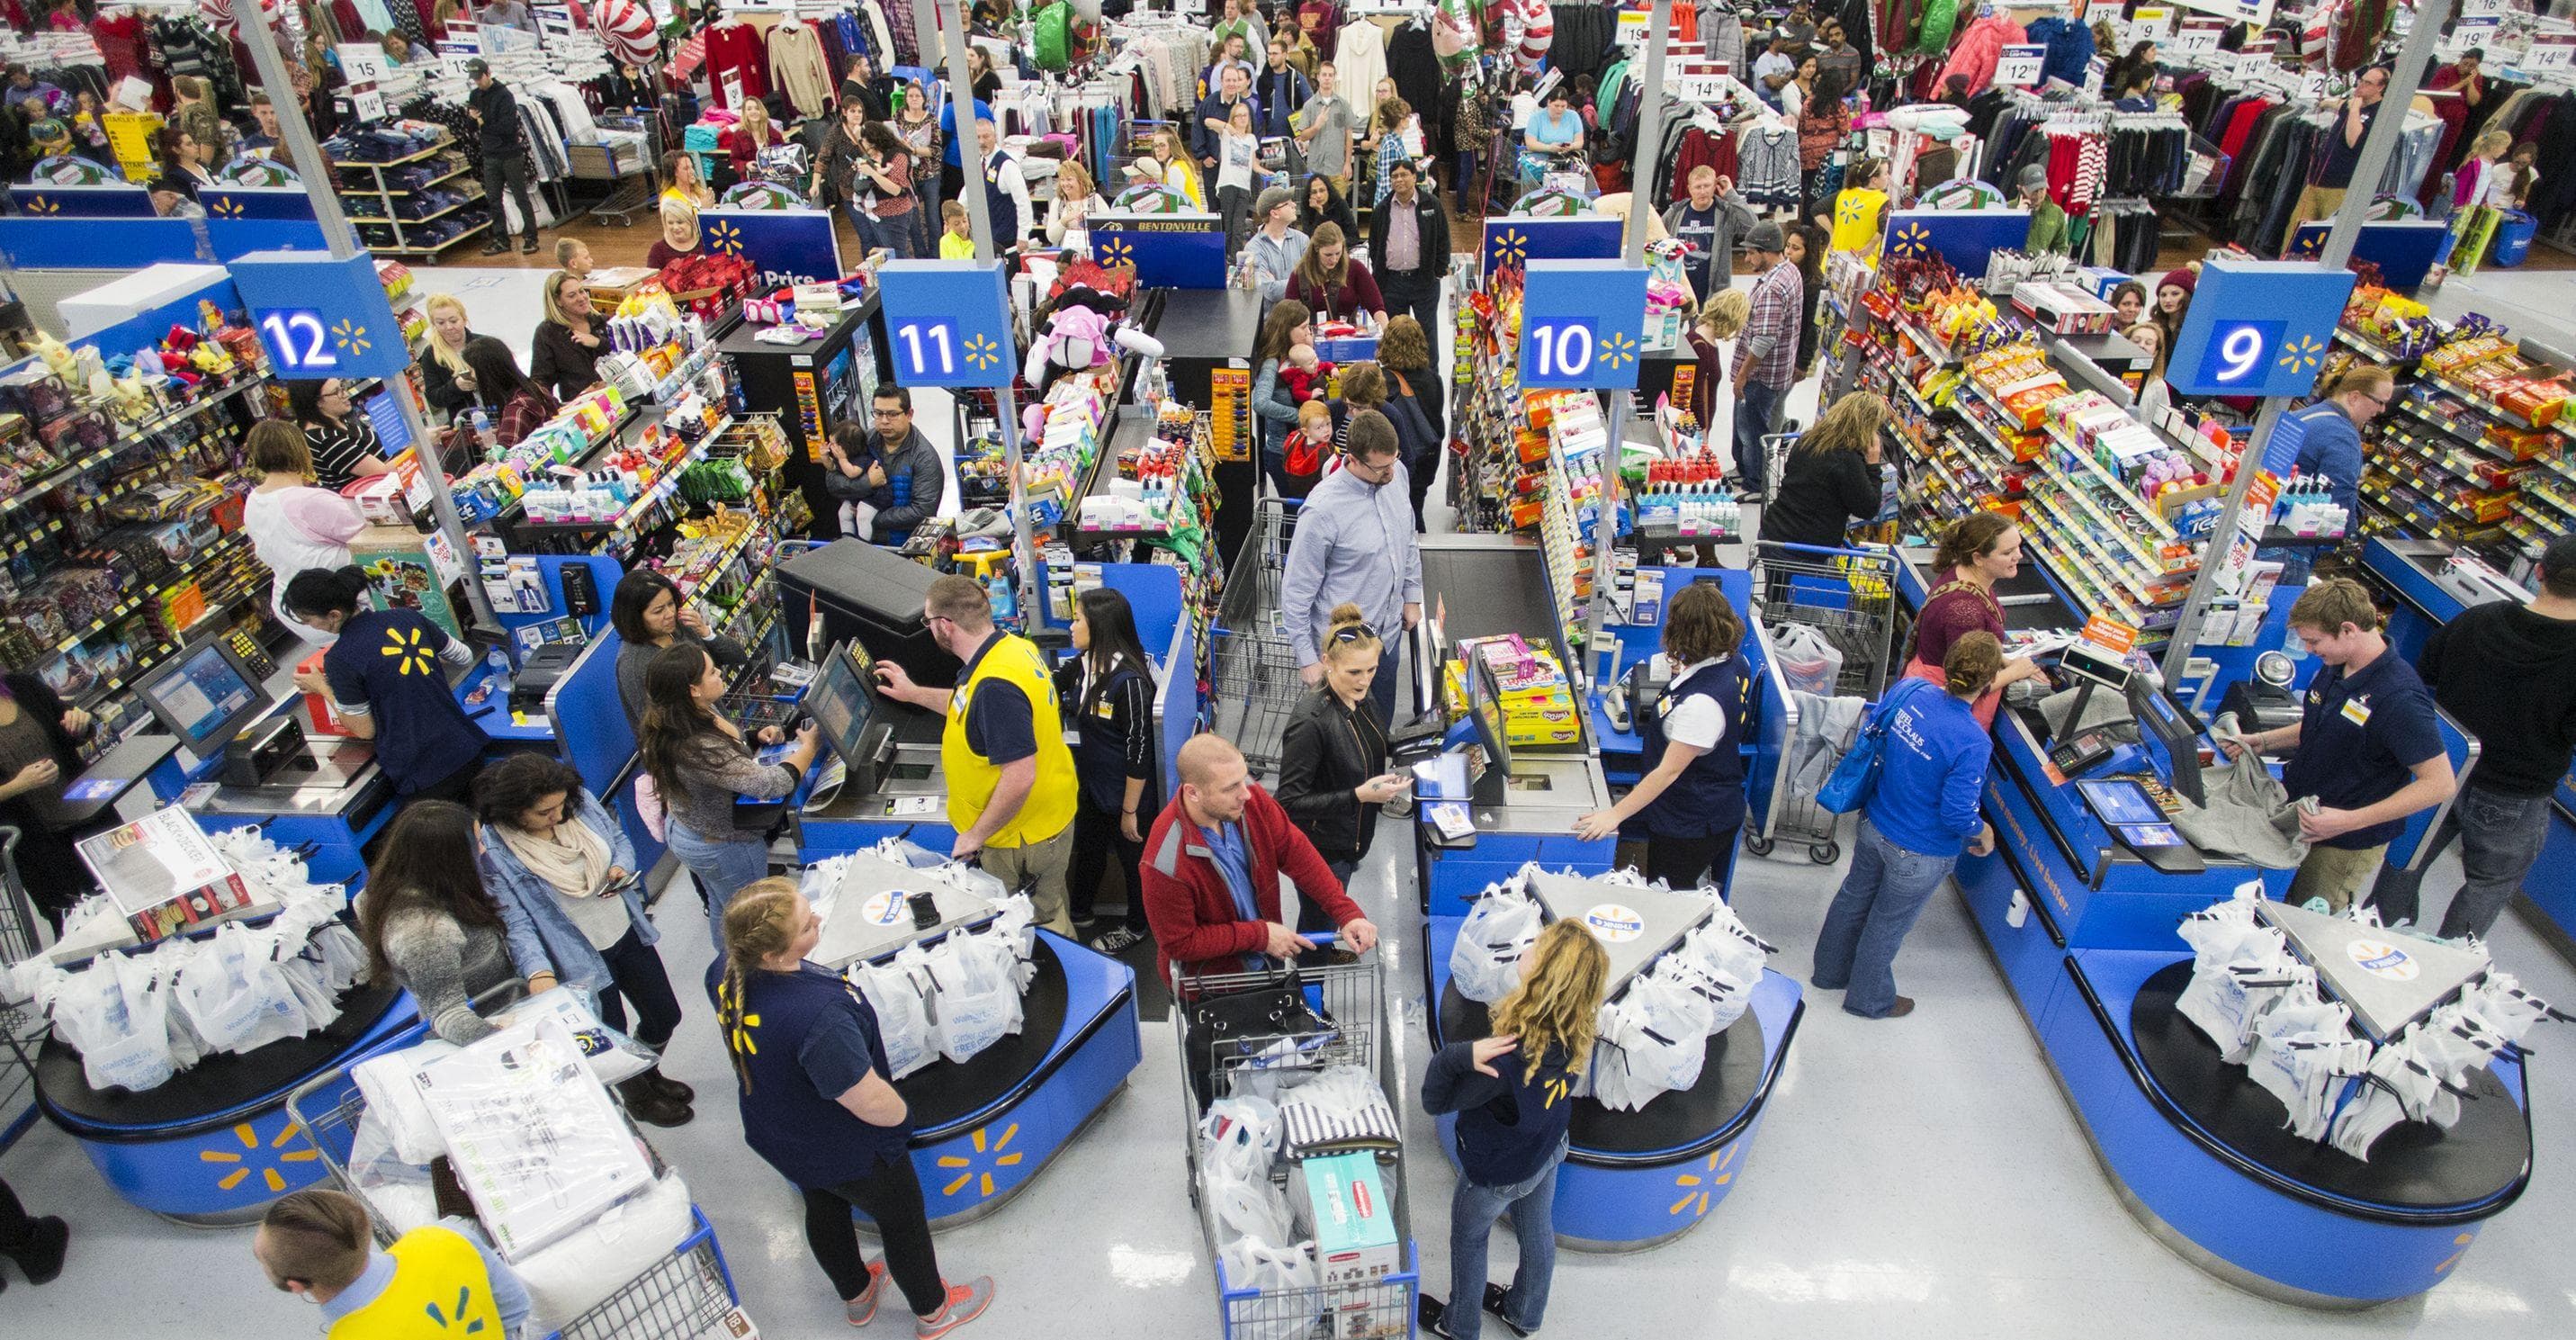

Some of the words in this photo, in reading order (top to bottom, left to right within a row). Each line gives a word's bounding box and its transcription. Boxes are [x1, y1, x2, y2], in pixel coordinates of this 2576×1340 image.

[1138, 222, 1210, 231] BENTONVILLE
[264, 315, 337, 365] 12
[900, 324, 954, 373] 11
[1533, 324, 1593, 375] 10
[2216, 328, 2262, 382] 9
[458, 502, 477, 519] CE
[2231, 543, 2248, 561] Save
[1989, 781, 2005, 808] Save
[2005, 808, 2028, 850] money.
[2028, 843, 2044, 873] Live
[2042, 867, 2069, 916] better.
[954, 1042, 976, 1055] FREE
[727, 1314, 741, 1327] 18
